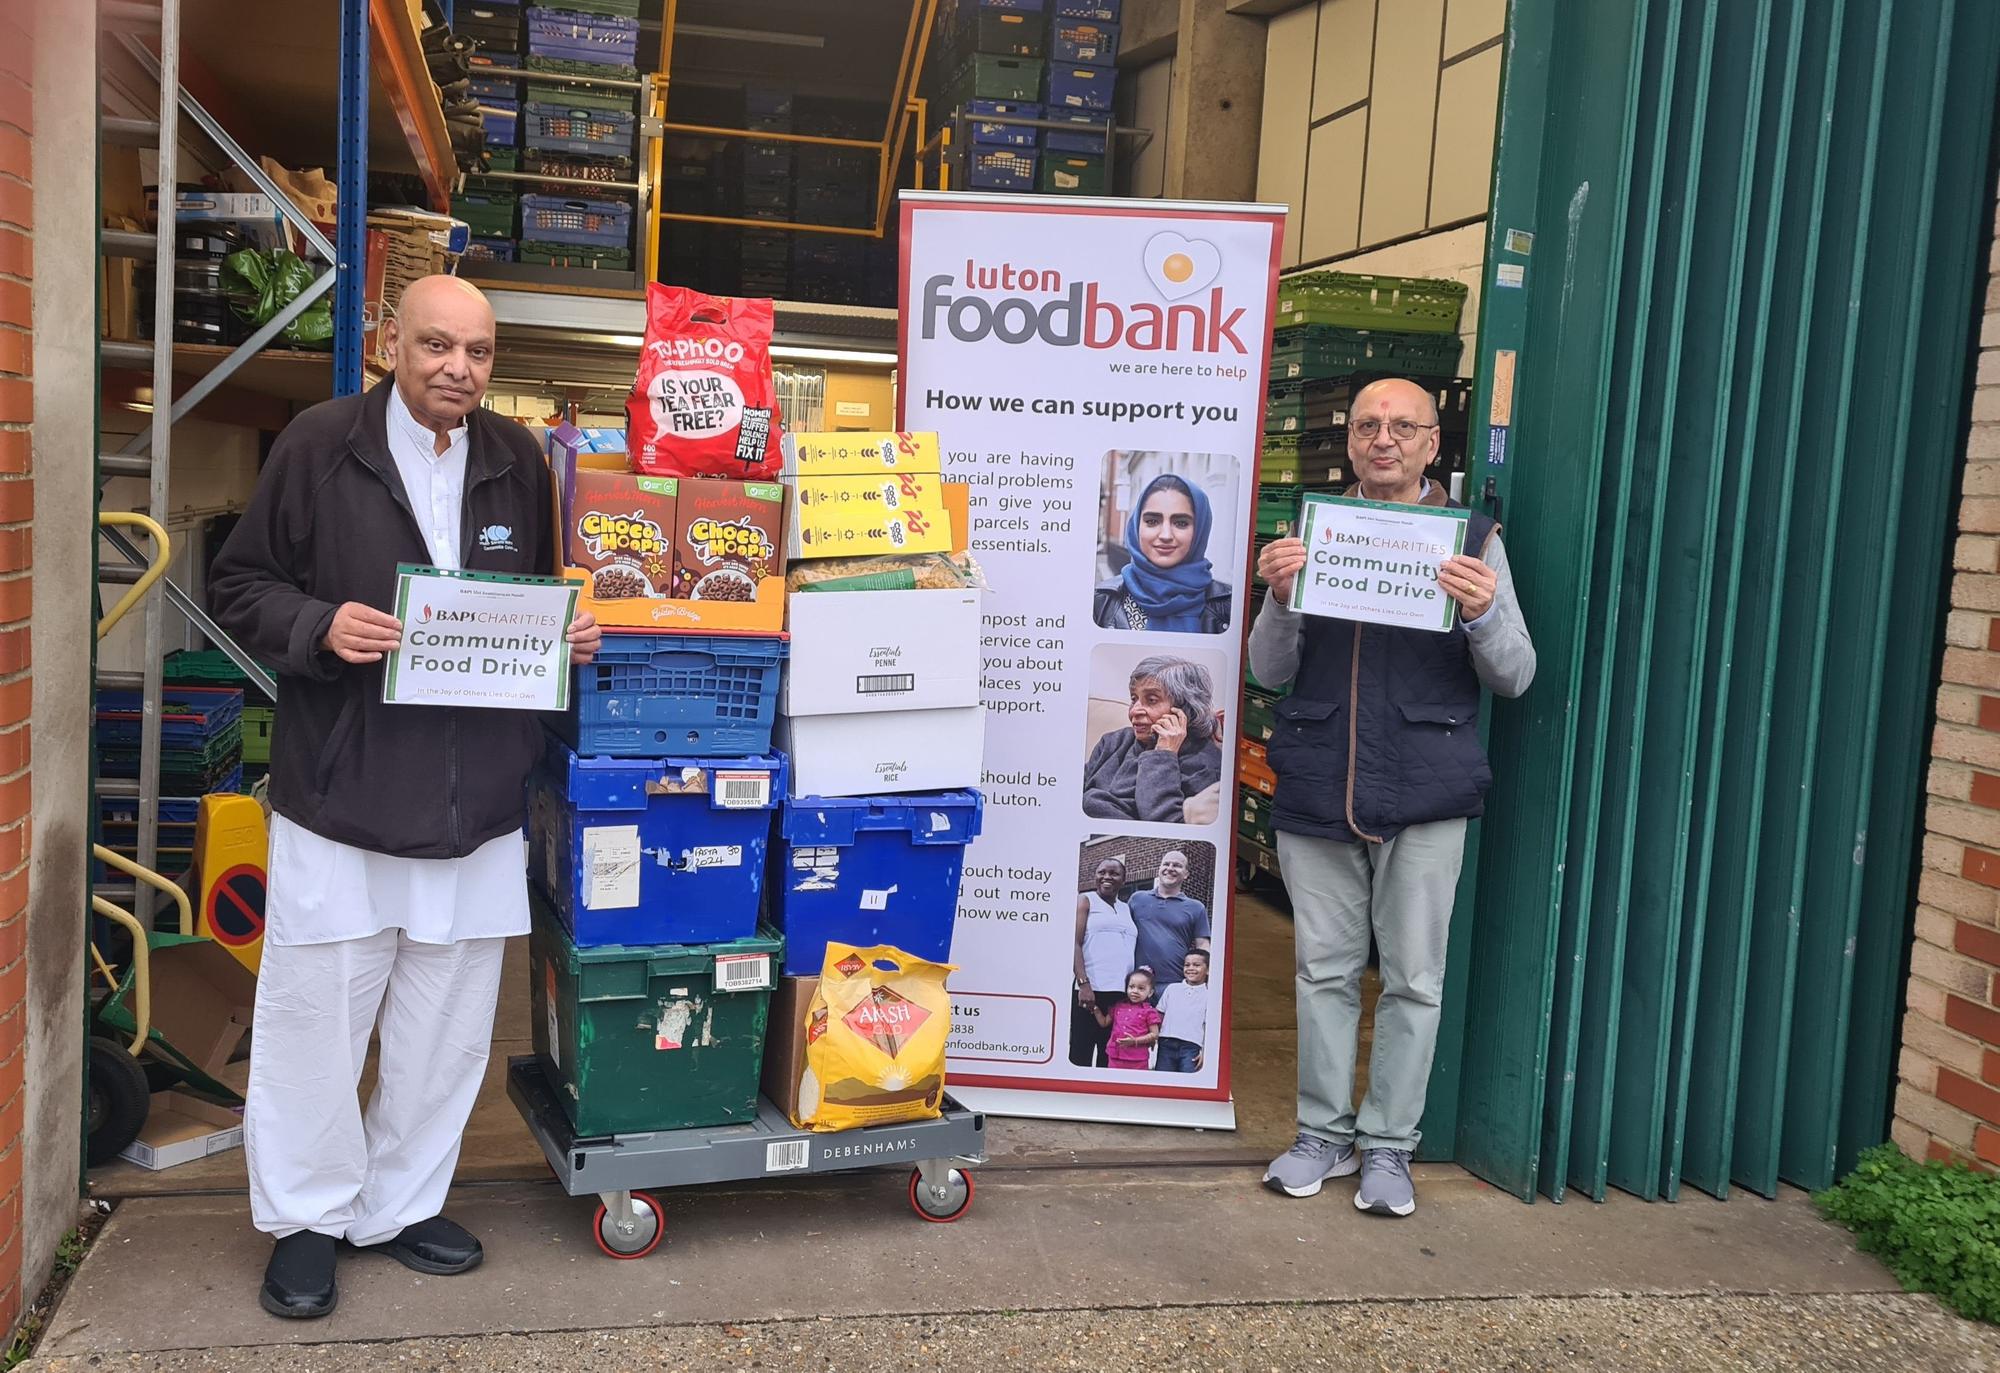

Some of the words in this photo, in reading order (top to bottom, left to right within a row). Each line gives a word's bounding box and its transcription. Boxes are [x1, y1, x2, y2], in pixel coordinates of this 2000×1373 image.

[966, 259, 1061, 292] luton
[922, 274, 1249, 355] foodbank
[1109, 362, 1131, 375] we
[1134, 363, 1157, 376] are
[1161, 361, 1193, 376] here
[1197, 364, 1212, 377] to
[1216, 364, 1247, 381] help
[661, 379, 677, 394] IS
[680, 377, 724, 395] YOUR
[657, 395, 690, 413] TEA
[691, 392, 736, 409] FEAR
[925, 389, 983, 410] How
[989, 395, 1025, 412] we
[1031, 397, 1075, 415] can
[1082, 400, 1185, 422] support
[1191, 404, 1239, 425] you
[672, 410, 725, 432] FREE?
[743, 407, 771, 418] WOMEN
[740, 429, 768, 440] VIOLENCE
[741, 420, 769, 434] SUFFER
[739, 436, 757, 446] HELP
[757, 439, 767, 448] US
[736, 444, 754, 459] FIX
[755, 447, 765, 461] IT
[948, 451, 977, 465] you
[986, 452, 1011, 465] are
[1020, 451, 1074, 471] having
[940, 472, 994, 485] nancial
[998, 473, 1073, 489] problems
[969, 496, 988, 507] an
[999, 494, 1032, 511] give
[1042, 499, 1072, 513] you
[973, 516, 1029, 531] parcels
[1040, 518, 1071, 532] and
[971, 538, 1052, 553] essentials.
[1314, 550, 1440, 581] Community
[1315, 572, 1369, 592] Food
[1377, 580, 1437, 600] Drive
[982, 614, 1027, 628] npost
[1035, 614, 1065, 628] and
[409, 630, 553, 655] Community
[1036, 637, 1064, 650] can
[410, 654, 472, 673] Food
[482, 658, 547, 677] Drive
[874, 658, 897, 668] PENNE
[983, 657, 1012, 670] you
[1016, 656, 1064, 671] about
[426, 687, 438, 695] the
[440, 688, 453, 696] Joy
[463, 689, 487, 697] Others
[979, 675, 1021, 690] laces
[1032, 679, 1062, 694] you
[883, 773, 899, 782] RICE
[980, 770, 1031, 785] should
[1037, 772, 1057, 786] be
[992, 792, 1042, 807] Luton.
[695, 856, 725, 867] 2024
[1007, 866, 1052, 884] today
[973, 888, 1000, 899] out
[1010, 889, 1051, 902] more
[957, 905, 992, 919] how
[995, 909, 1018, 921] we
[1022, 911, 1049, 922] can
[963, 1006, 980, 1017] us
[823, 1138, 917, 1159] DEBENHAMS
